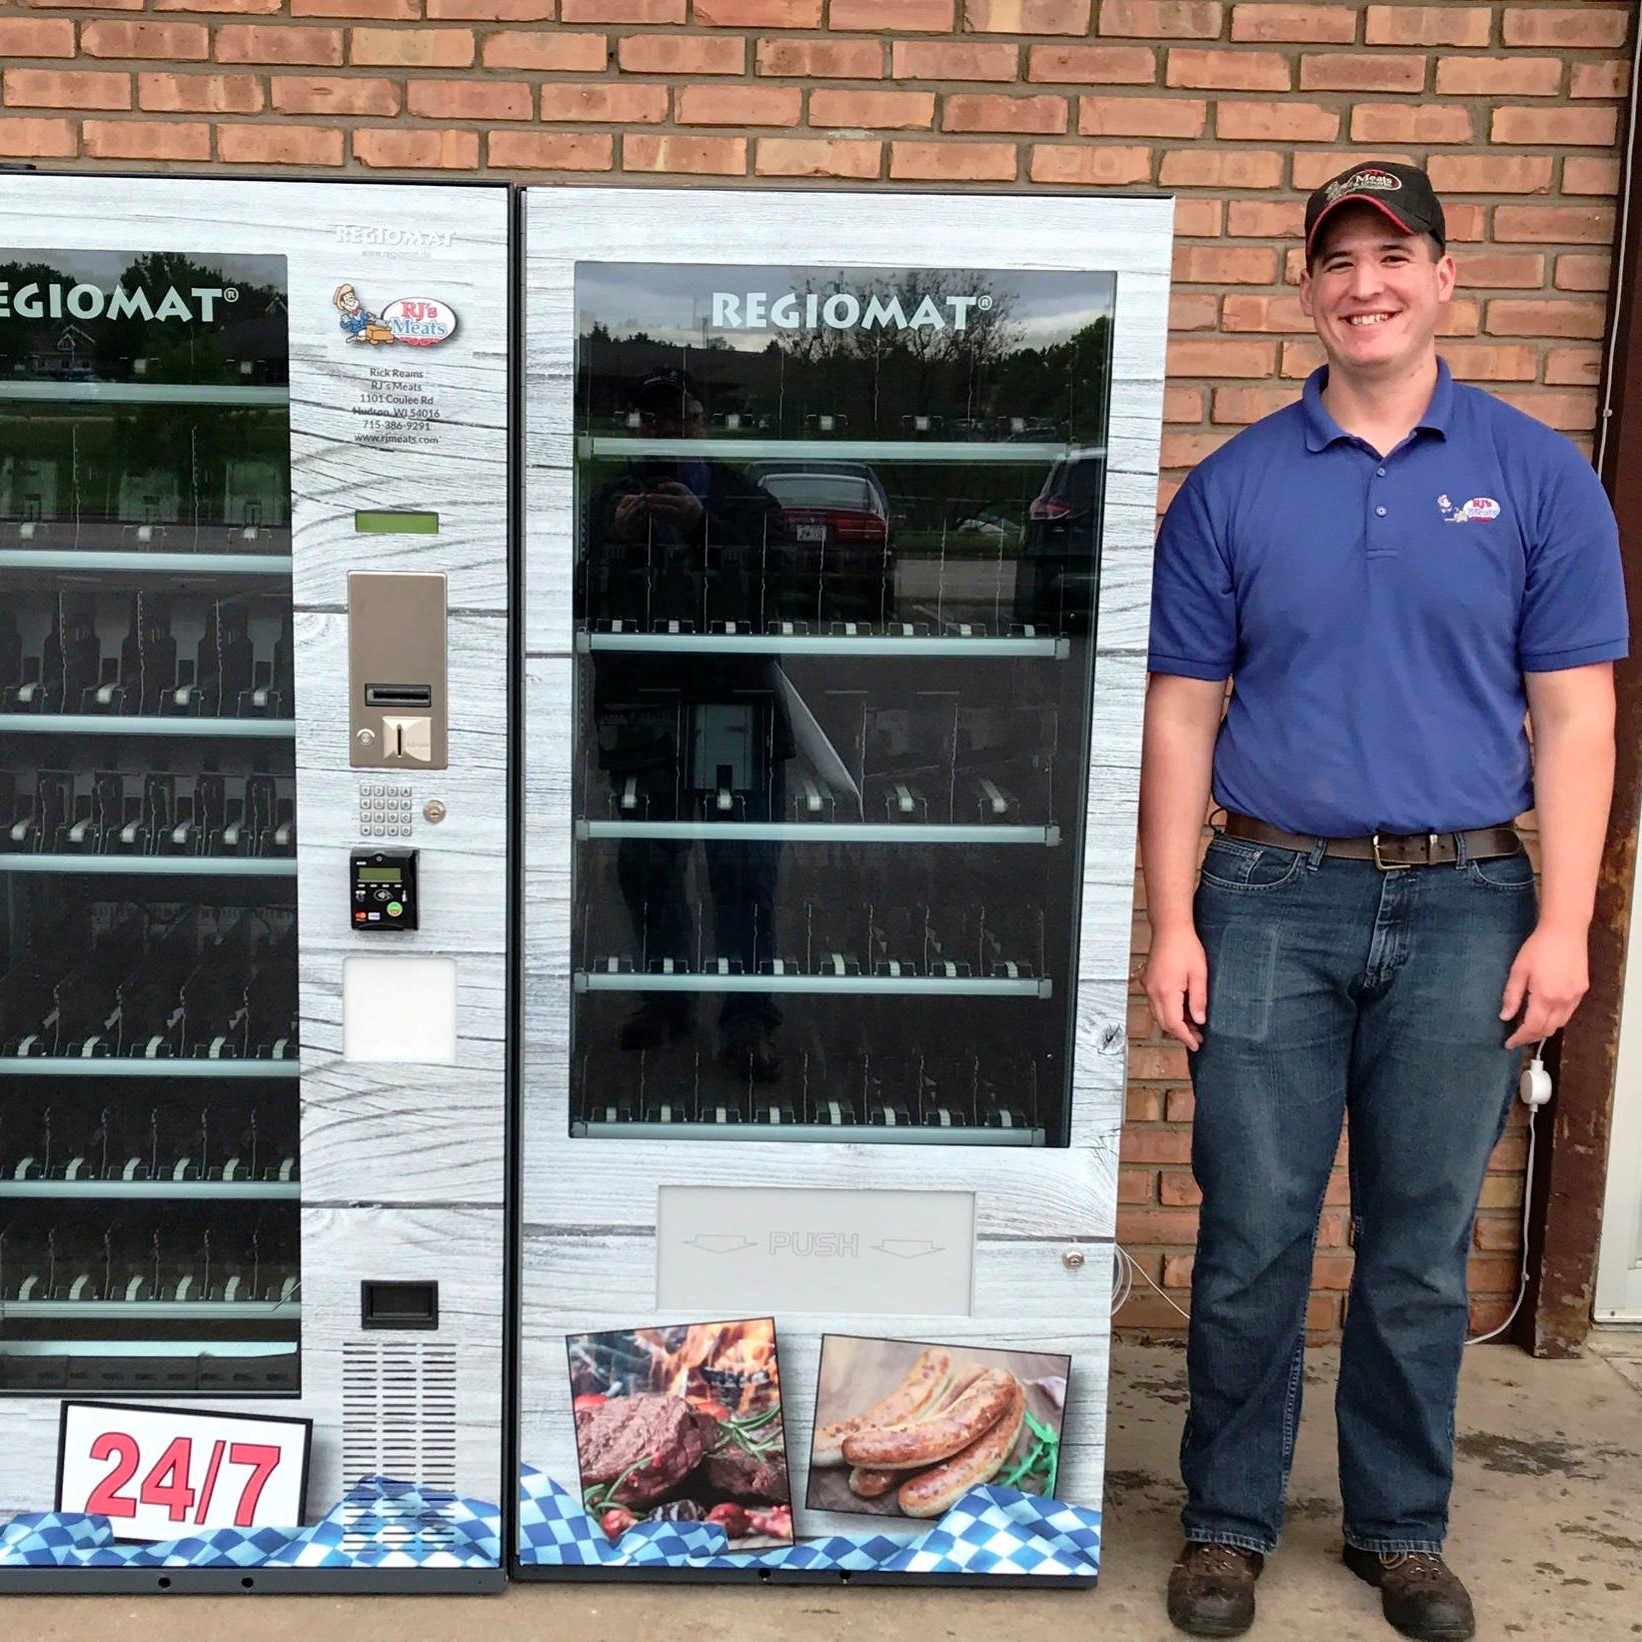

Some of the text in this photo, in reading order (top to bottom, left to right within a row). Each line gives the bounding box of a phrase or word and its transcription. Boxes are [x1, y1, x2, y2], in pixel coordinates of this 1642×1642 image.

[401, 301, 438, 321] RJ's
[391, 317, 447, 336] Meats
[370, 367, 424, 378] Rick Reams
[392, 382, 422, 391] Meats
[360, 394, 434, 404] 1101 Coulee Rd
[393, 408, 408, 417] WI
[410, 409, 440, 418] 54016
[363, 419, 431, 431] 715-386-9291
[354, 434, 439, 444] www.rjmeats.com
[769, 1231, 859, 1257] PUSH
[84, 1431, 282, 1527] 24/7
